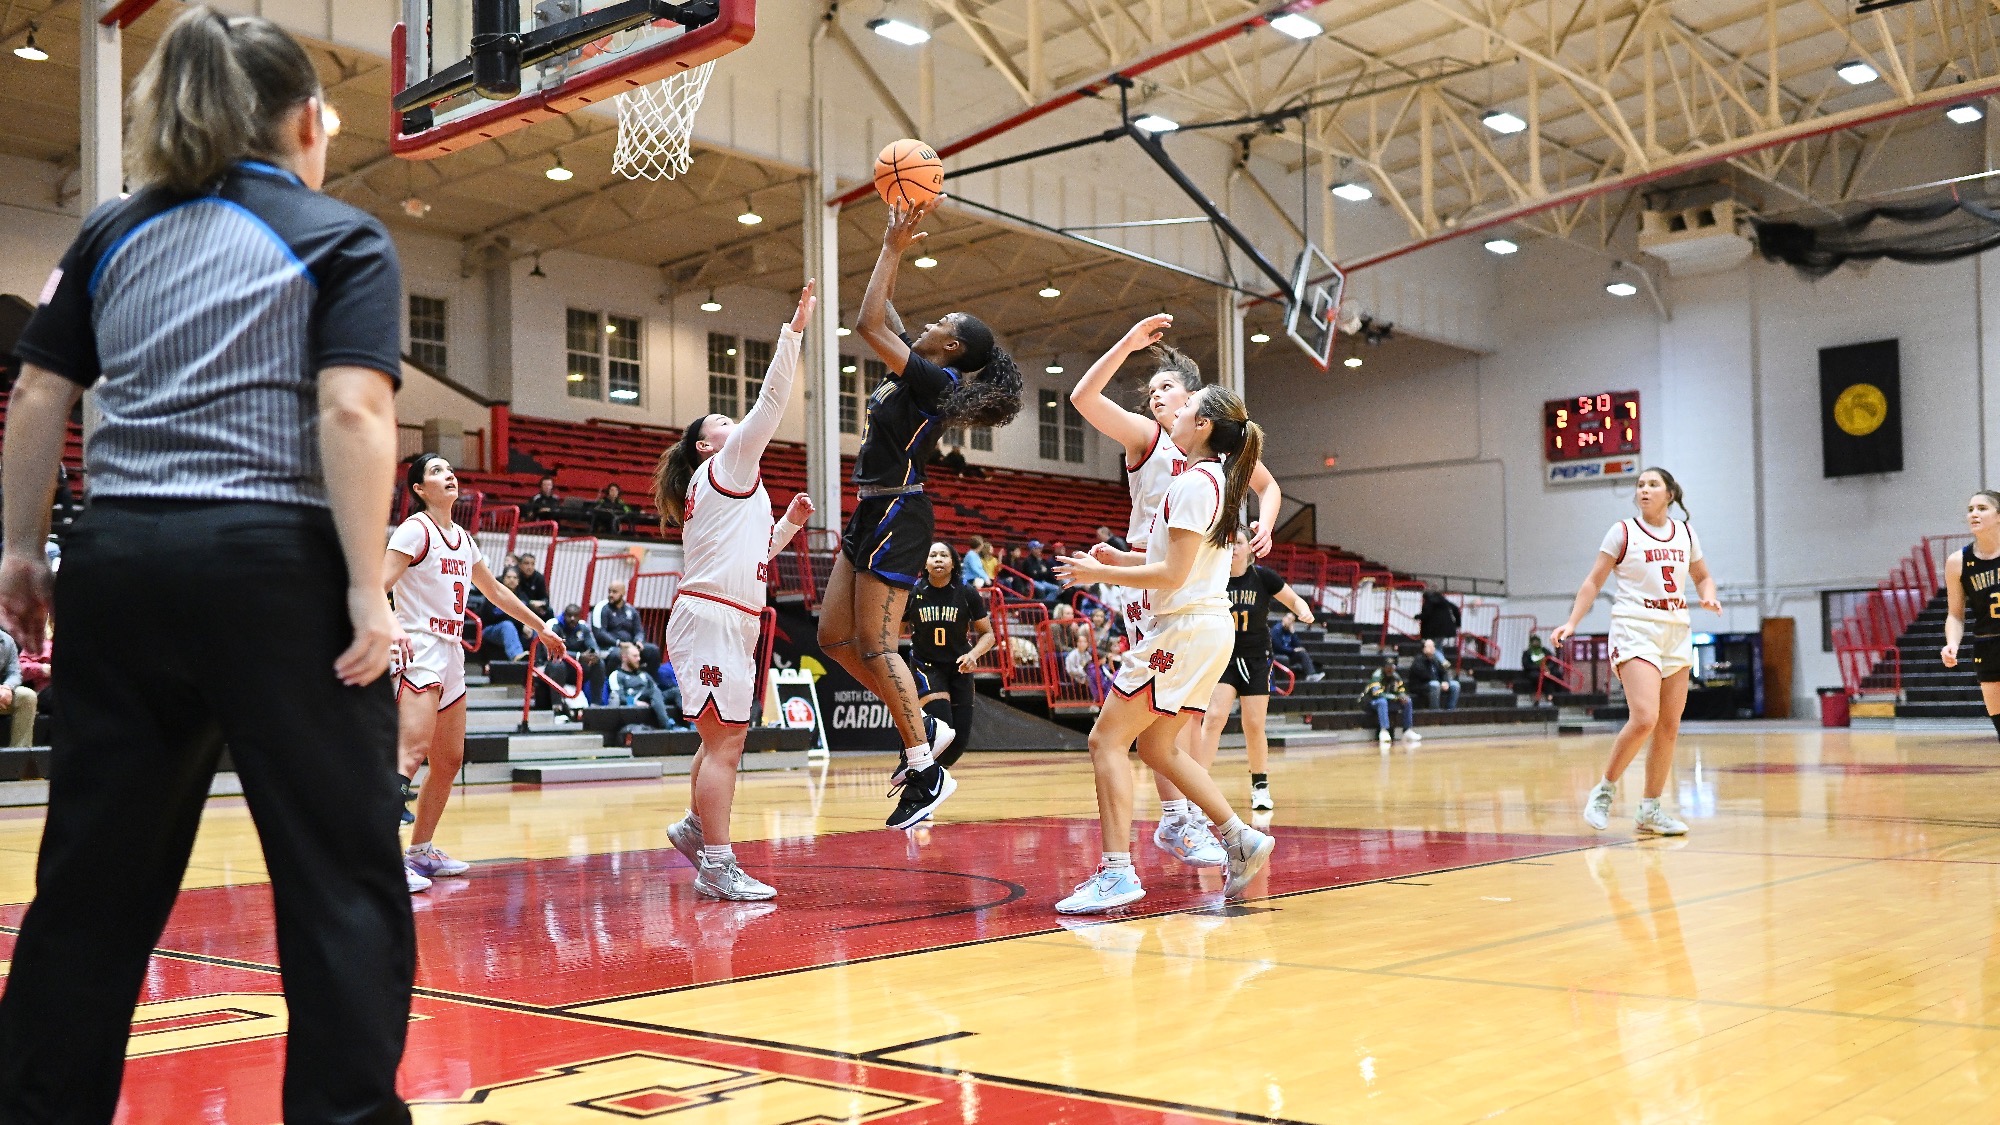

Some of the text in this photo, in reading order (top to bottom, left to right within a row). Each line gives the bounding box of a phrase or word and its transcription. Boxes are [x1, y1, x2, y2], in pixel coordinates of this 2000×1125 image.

[1556, 409, 1567, 428] 2
[1644, 549, 1684, 562] NORTH
[1661, 566, 1677, 593] 5
[453, 581, 464, 614] 3
[1240, 589, 1258, 606] PARK
[919, 605, 959, 622] NORTH PARK
[429, 616, 464, 638] CENT
[934, 627, 946, 646] 0
[834, 691, 862, 702] NORTH
